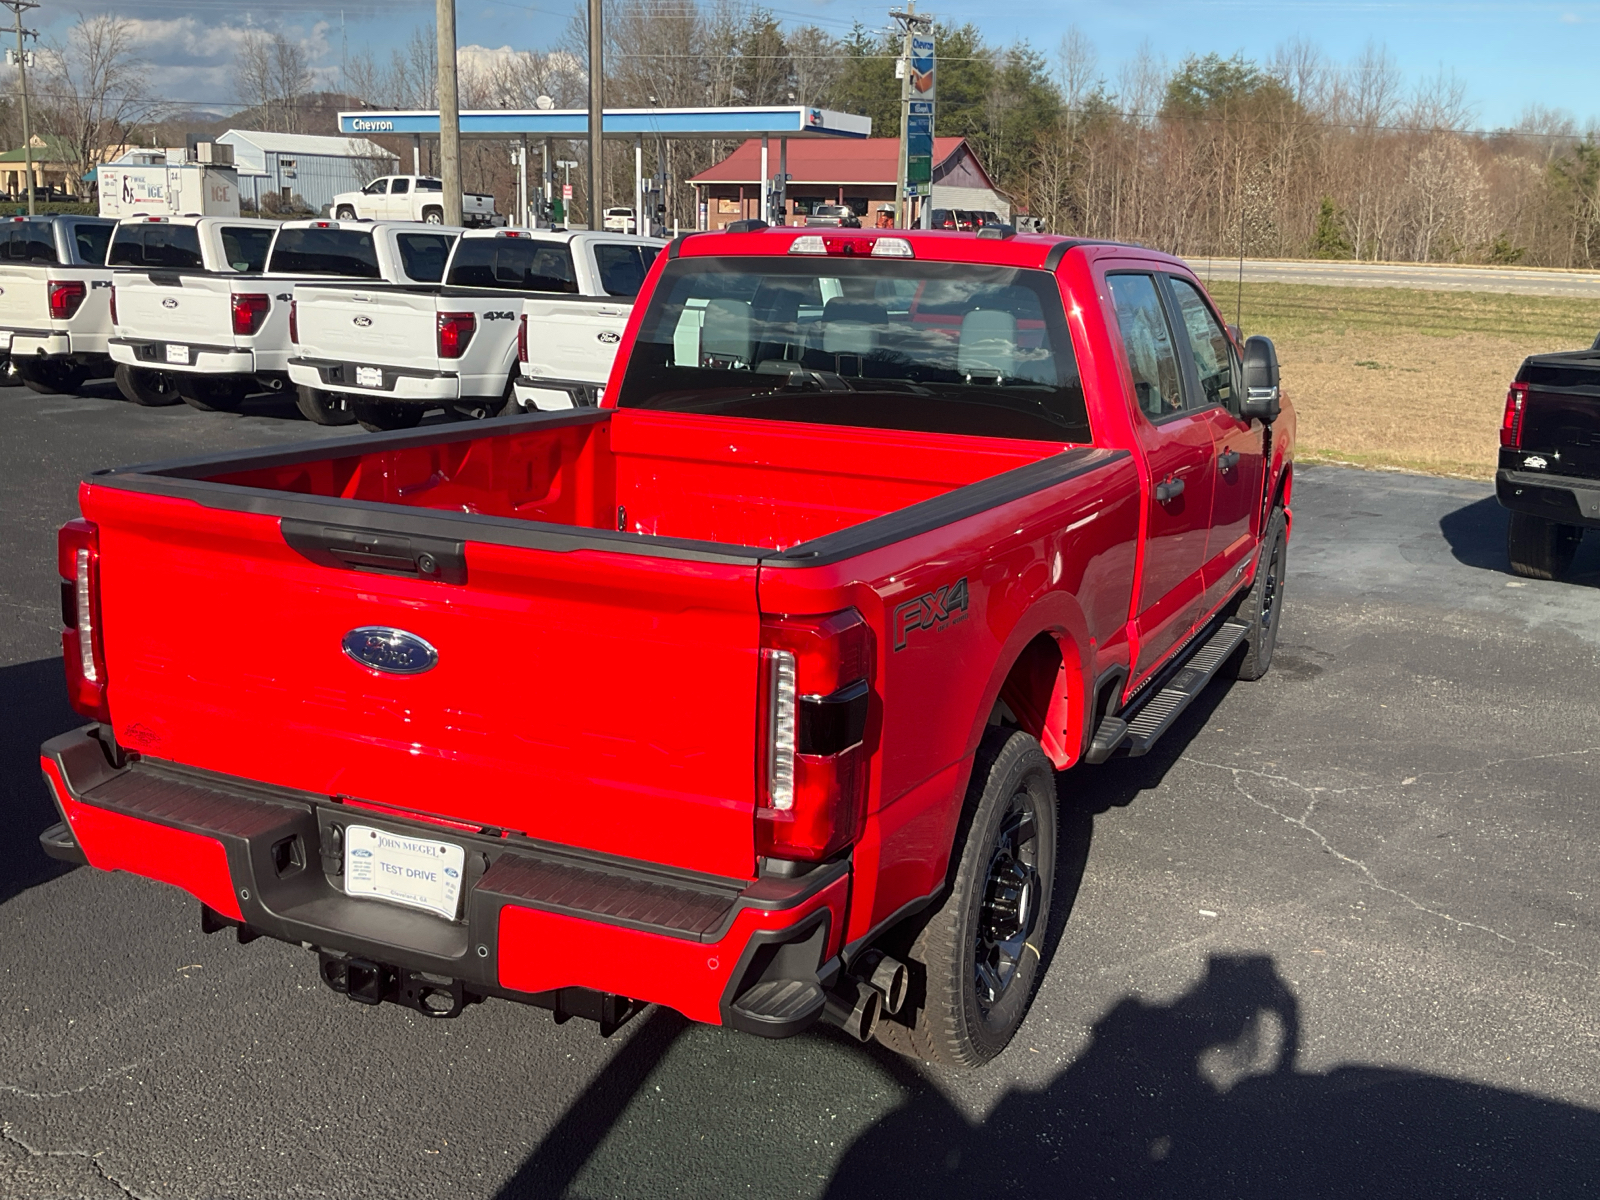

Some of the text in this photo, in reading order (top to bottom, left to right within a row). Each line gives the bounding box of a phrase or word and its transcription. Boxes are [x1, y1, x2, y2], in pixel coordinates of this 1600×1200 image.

[912, 38, 933, 50] Chevron
[353, 119, 393, 131] Chevron
[171, 172, 178, 180] 24
[147, 185, 163, 198] ICE
[211, 186, 230, 202] ICE
[91, 281, 113, 289] FX
[894, 576, 968, 652] FX4
[378, 836, 439, 858] JOHN MEGEL
[380, 862, 403, 876] TEST
[406, 868, 437, 882] DRIVE
